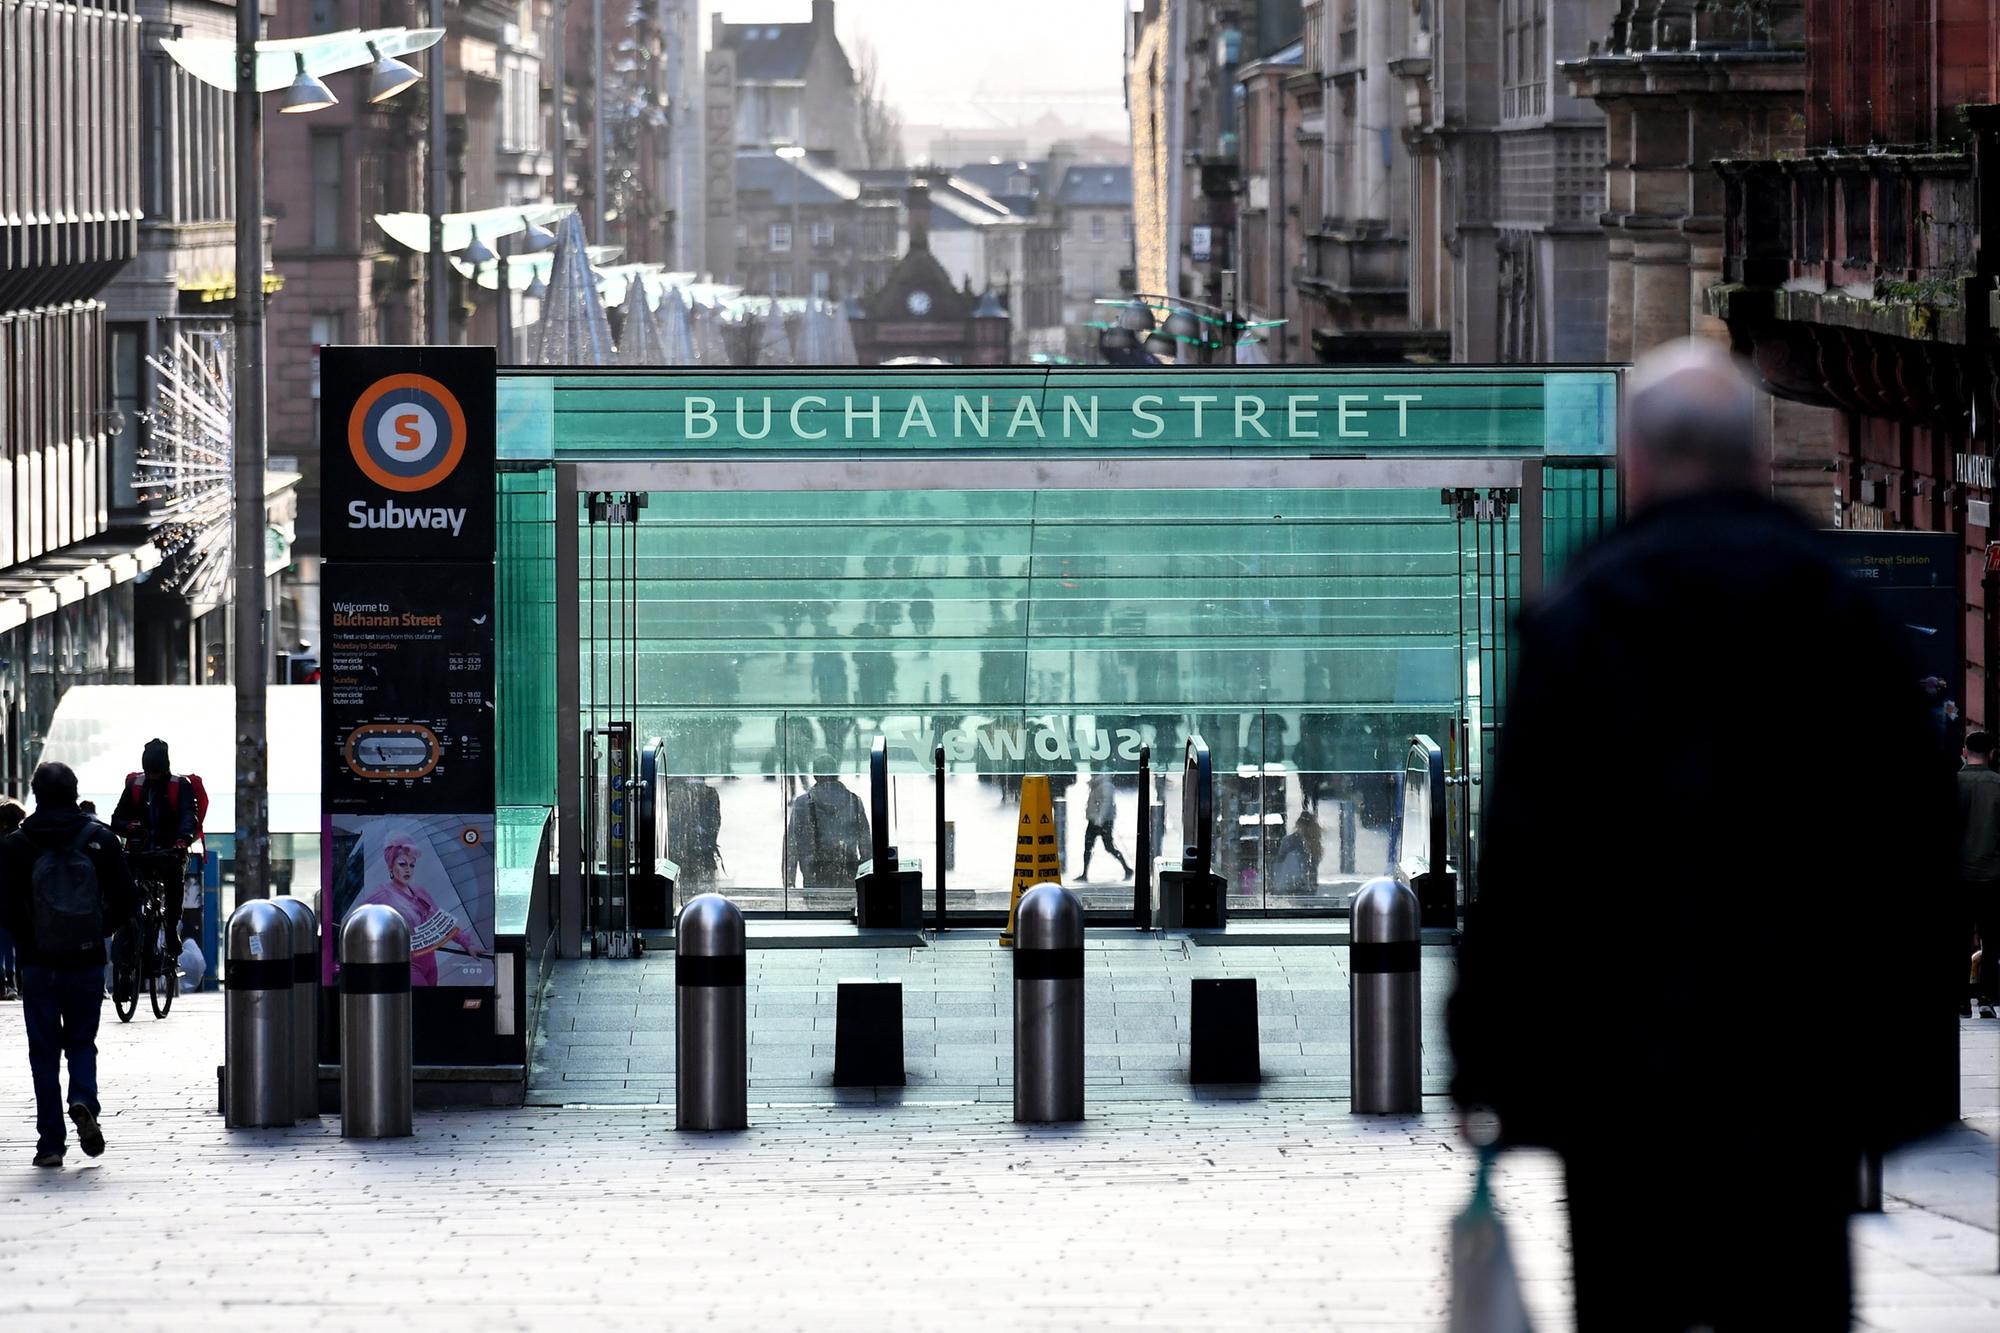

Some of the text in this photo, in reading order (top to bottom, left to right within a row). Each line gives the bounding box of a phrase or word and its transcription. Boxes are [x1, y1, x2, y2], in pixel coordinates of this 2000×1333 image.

[684, 394, 1423, 440] BUCHANAN STREET
[394, 414, 421, 451] S
[347, 499, 467, 537] Subway
[1864, 555, 1893, 565] Street
[1896, 555, 1930, 565] Station
[332, 602, 389, 612] Welcome to
[333, 613, 442, 626] Buchanan Street
[333, 642, 360, 651] Monday
[368, 642, 398, 651] Saturday
[333, 676, 358, 685] Sunday
[423, 934, 440, 946] those
